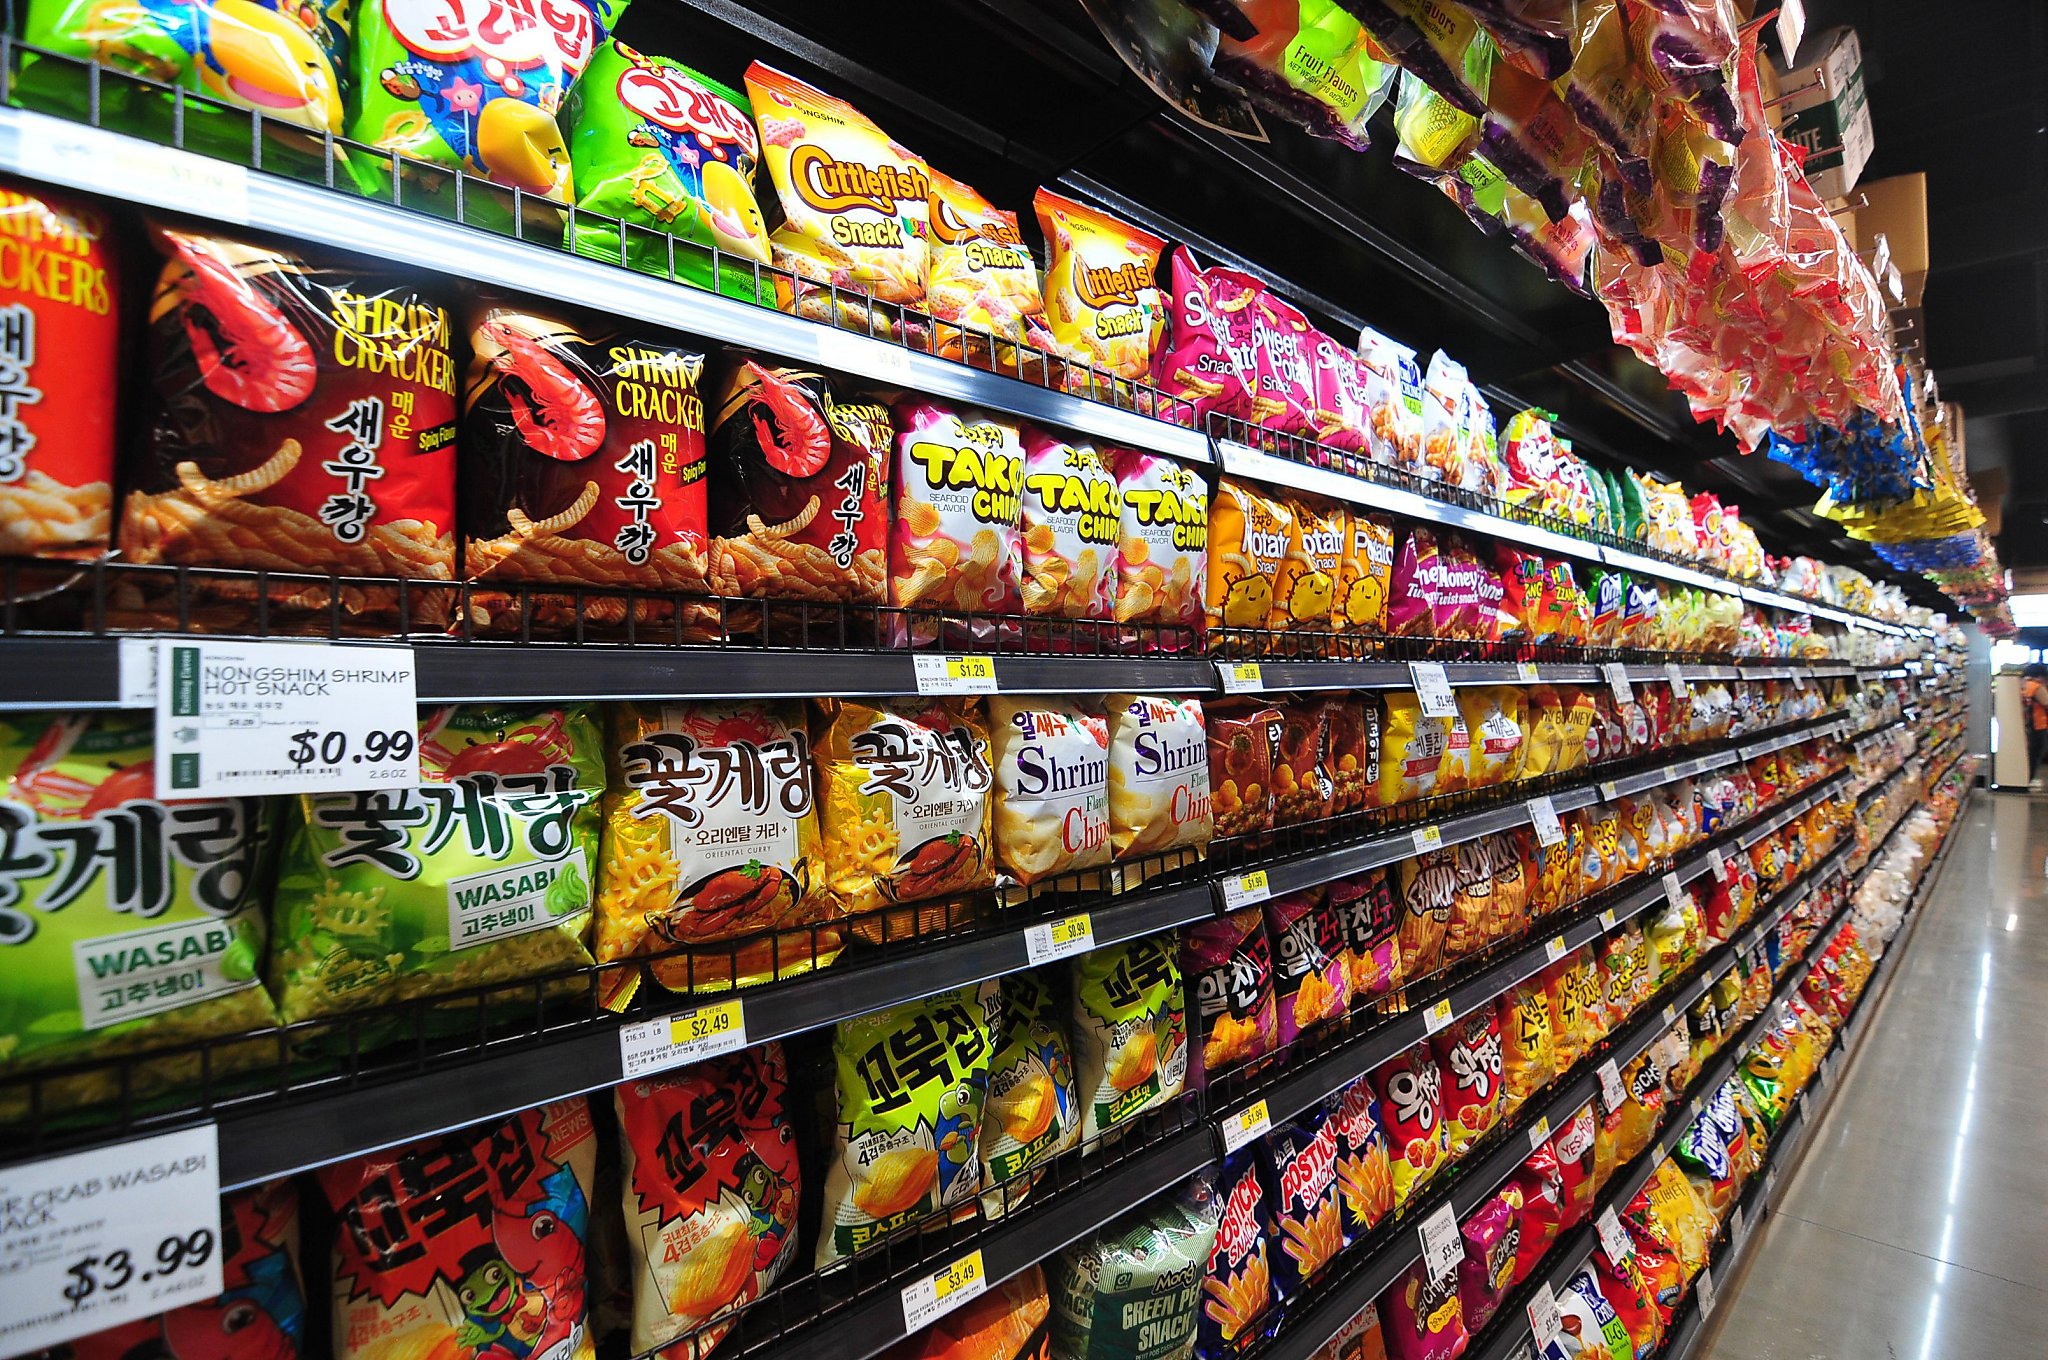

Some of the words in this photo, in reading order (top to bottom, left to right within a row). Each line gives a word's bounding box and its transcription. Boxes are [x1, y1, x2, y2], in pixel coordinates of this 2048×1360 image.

[1294, 45, 1325, 74] Fruit
[1322, 65, 1358, 103] Flavors
[790, 144, 929, 217] Cuttlefish
[831, 216, 904, 249] Snack
[966, 242, 1025, 272] Snack
[1095, 307, 1144, 341] Snack
[388, 390, 415, 441] 매운
[660, 431, 679, 475] 매운
[910, 441, 1025, 498] TAKO
[321, 394, 387, 546] 새우깡
[614, 436, 664, 568] 새우깡
[929, 493, 969, 505] SEAFOOD
[932, 504, 966, 514] FLAVOR
[1026, 473, 1121, 519] TAKO
[827, 459, 866, 571] 새우깡
[1046, 516, 1077, 527] SEAFOOD
[1049, 525, 1075, 535] FLAVOR
[1140, 529, 1172, 538] SEAFOOD
[1143, 536, 1170, 546] FLAVOR
[1172, 523, 1208, 553] CHIP
[204, 666, 326, 683] NONGSHIM
[332, 669, 411, 684] SHRIMP
[959, 664, 986, 678] $1.29
[204, 681, 249, 696] HOT
[255, 682, 330, 697] SNACK
[289, 728, 414, 769] $0.99
[852, 723, 993, 802] 꽃게랑
[620, 730, 812, 824] 꽃게랑
[911, 803, 955, 821] 오리엔탈
[918, 821, 949, 831] ORIENTAL
[695, 828, 753, 847] 오리엔탈
[755, 825, 780, 840] 커리
[704, 849, 745, 860] ORIENTAL
[746, 845, 772, 855] CURRY
[455, 868, 554, 911] WASABI
[461, 904, 535, 937] 고추냉이
[100, 970, 204, 1013] 고추냉이
[691, 1013, 730, 1037] $2.49
[856, 1003, 987, 1115] 꼬북칩
[1108, 1084, 1151, 1124] 콘스프맛
[550, 1112, 589, 1145] NEWS
[858, 1134, 887, 1151] 국내최초
[1348, 1110, 1377, 1151] SNACK
[857, 1149, 879, 1168] 4겹
[878, 1136, 911, 1154] 층층구조
[1281, 1118, 1338, 1214] POSTICK
[109, 1154, 207, 1191] WASABI
[1302, 1163, 1336, 1211] SNACK
[661, 1217, 701, 1245] 국내최초
[1206, 1162, 1263, 1275] POSTICK
[662, 1236, 691, 1264] 4겹
[1228, 1210, 1262, 1269] SNACK
[1442, 1236, 1461, 1261] $3.49
[63, 1228, 216, 1308] $3.99
[948, 1264, 975, 1290] $3.49
[1152, 1259, 1198, 1296] Mong
[1121, 1298, 1176, 1330] GREEN
[1138, 1316, 1192, 1352] SNACK
